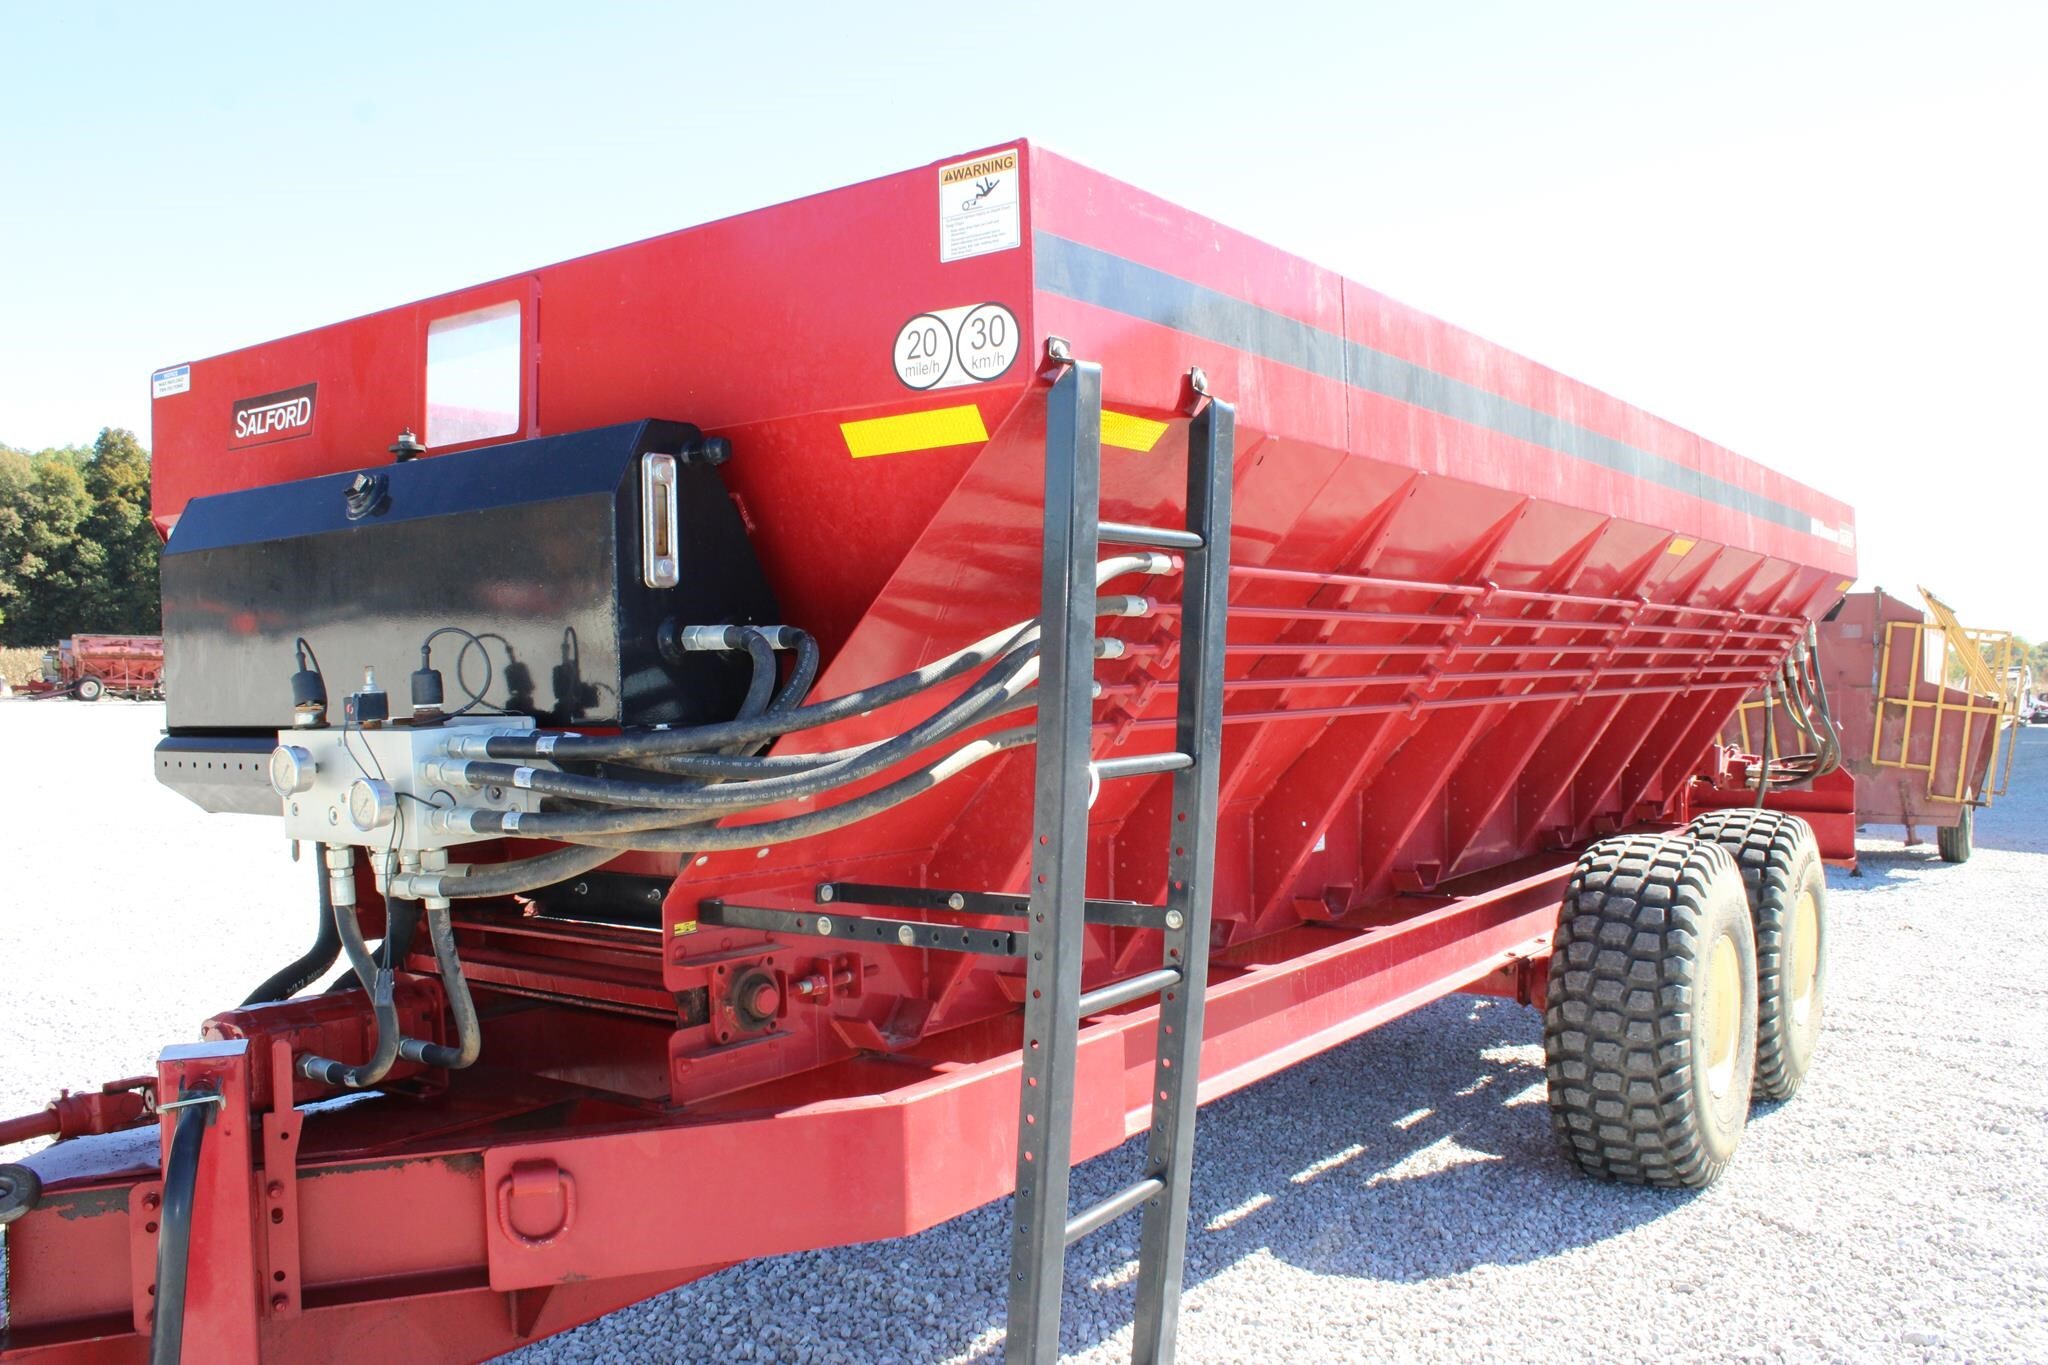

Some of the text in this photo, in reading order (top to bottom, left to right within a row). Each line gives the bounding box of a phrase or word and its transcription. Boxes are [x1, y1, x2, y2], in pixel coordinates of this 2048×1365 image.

[953, 156, 1014, 181] WARNING
[906, 327, 937, 360] 20
[970, 313, 1006, 350] 30
[905, 360, 940, 378] mile/h
[971, 352, 1005, 371] km/h
[235, 396, 311, 439] SALFORD
